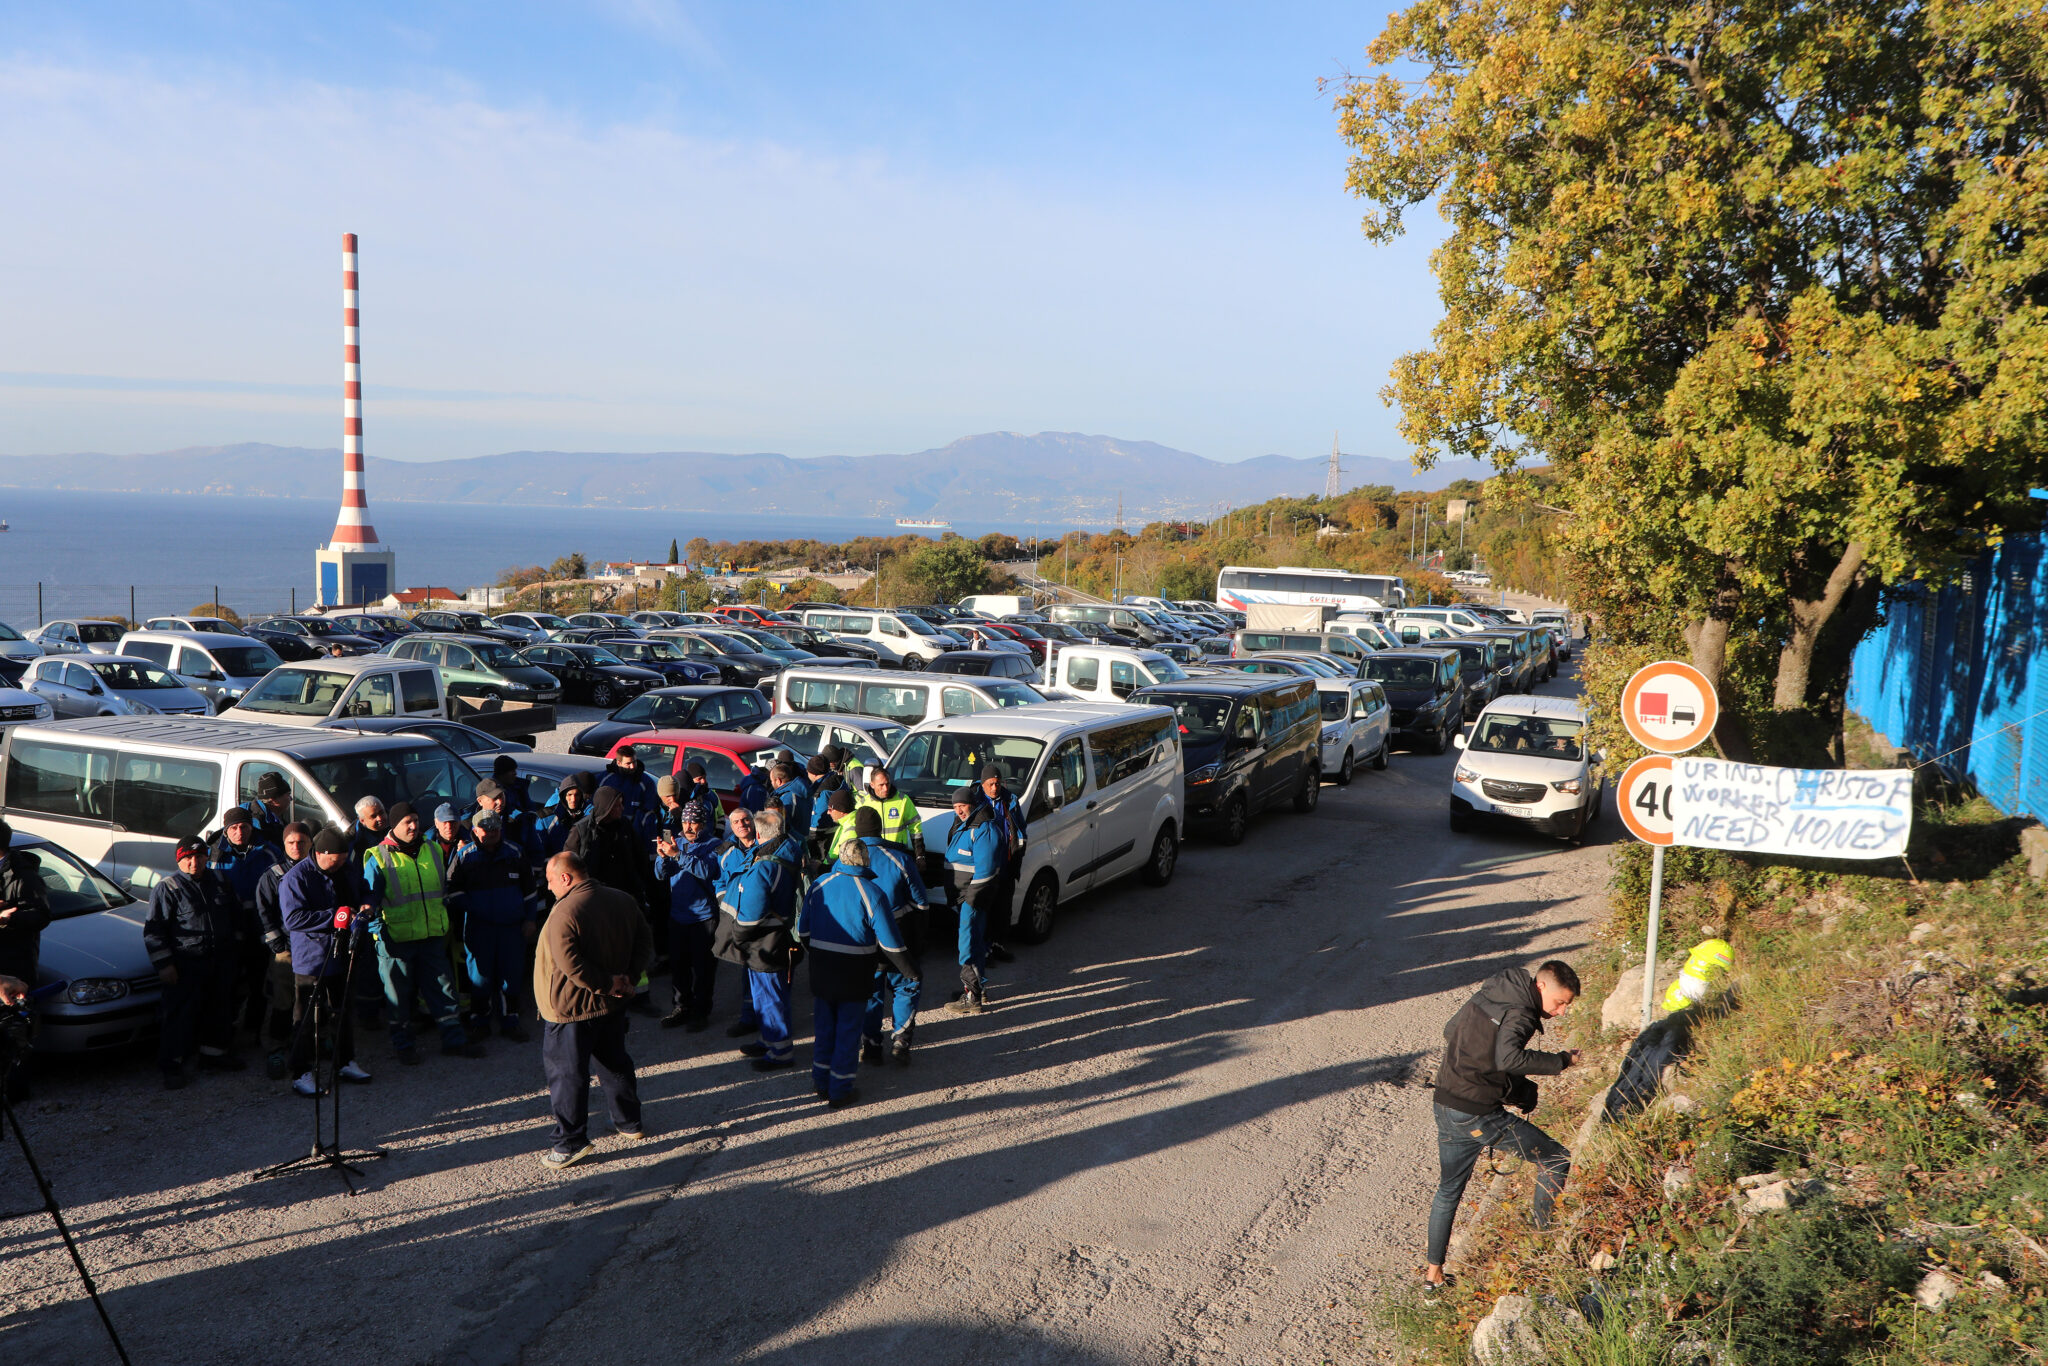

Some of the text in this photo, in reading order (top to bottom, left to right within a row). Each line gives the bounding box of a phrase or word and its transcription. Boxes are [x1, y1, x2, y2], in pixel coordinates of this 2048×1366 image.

[1682, 783, 1784, 827] WORKER
[1683, 813, 1907, 849] NEED MONEY
